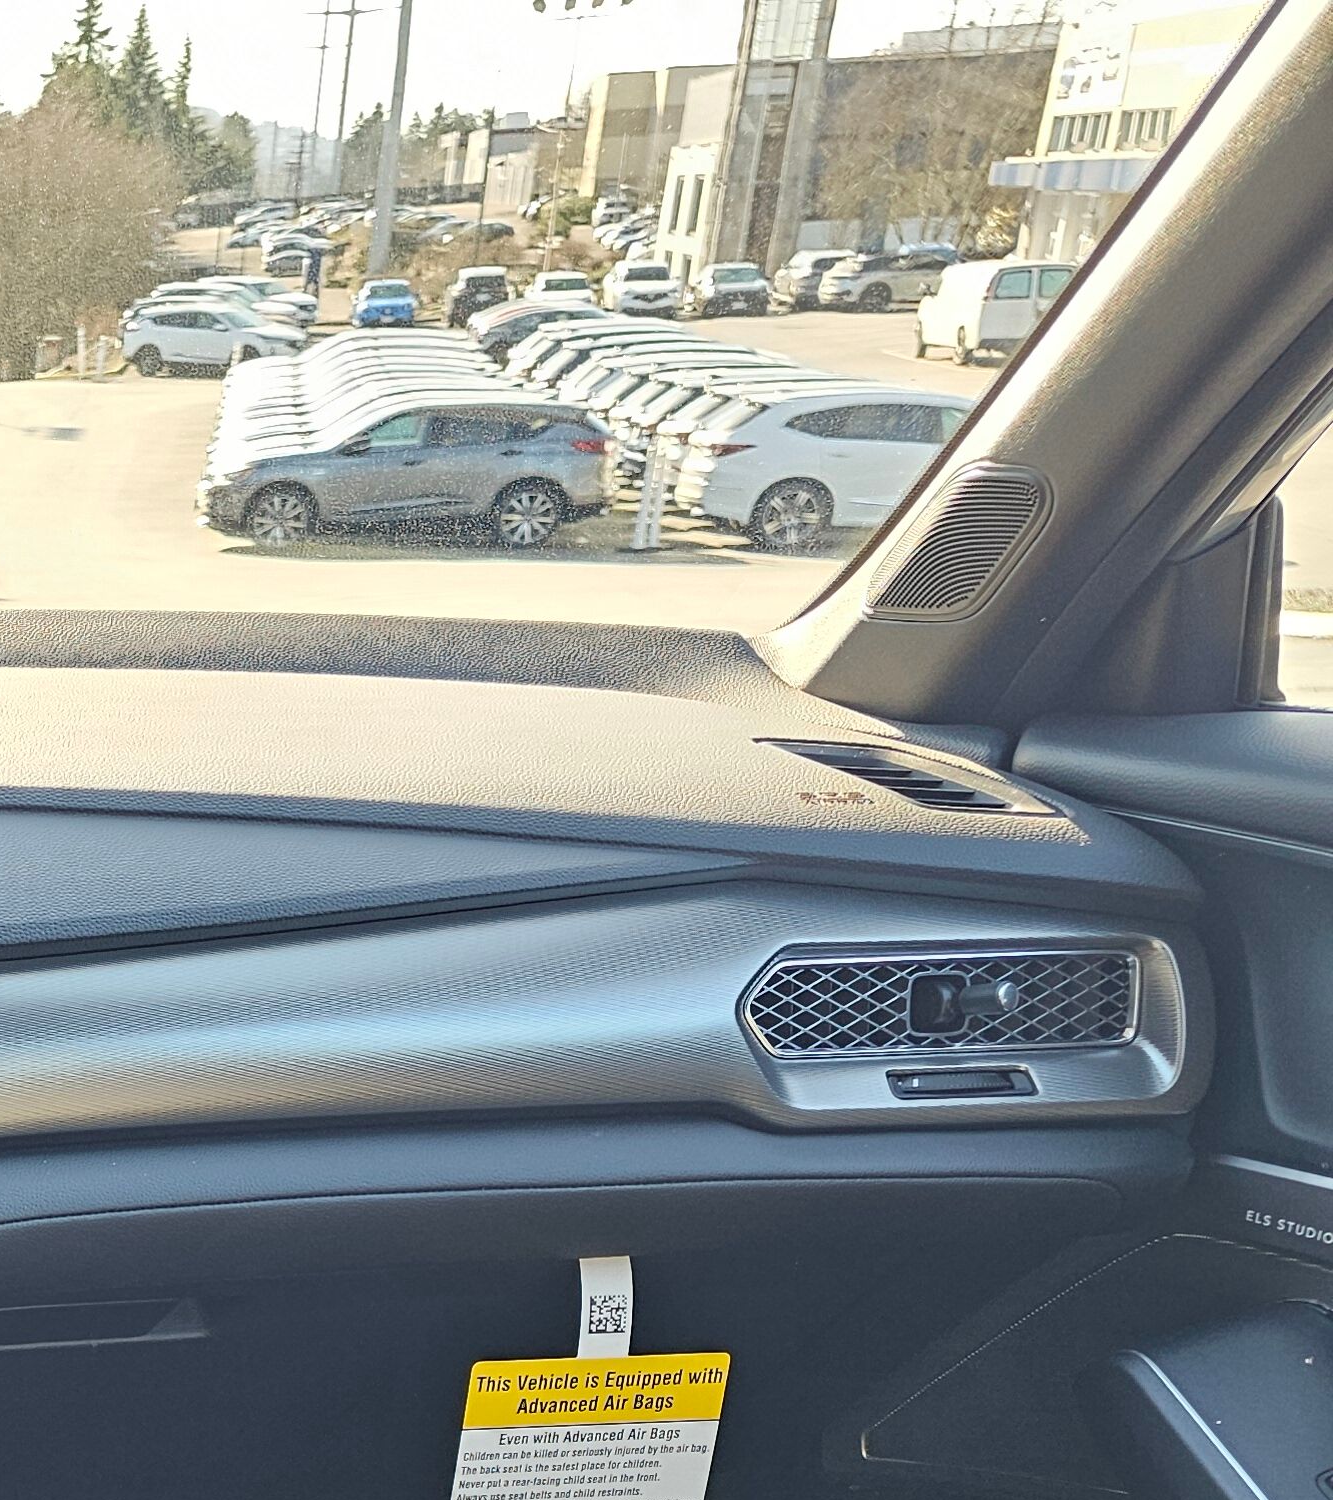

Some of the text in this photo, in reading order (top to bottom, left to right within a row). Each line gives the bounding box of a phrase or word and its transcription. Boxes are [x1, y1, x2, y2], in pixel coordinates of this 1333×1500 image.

[1245, 1210, 1333, 1244] ELS STUDIO
[477, 1368, 723, 1392] This Vehicle is Equipped with
[517, 1394, 674, 1414] Advanced Air Bags
[499, 1427, 681, 1445] Even with Advanced Air Bags
[463, 1444, 710, 1462] Children can be killed or seriously injured by the air bag.
[461, 1459, 662, 1475] The back seat is the safest place for children.
[458, 1480, 485, 1489] Never
[487, 1479, 501, 1489] put
[511, 1477, 561, 1487] rear-facing
[563, 1475, 585, 1485] child
[587, 1475, 606, 1484] seat
[609, 1474, 618, 1483] in
[620, 1474, 634, 1482] the
[636, 1472, 660, 1482] front.
